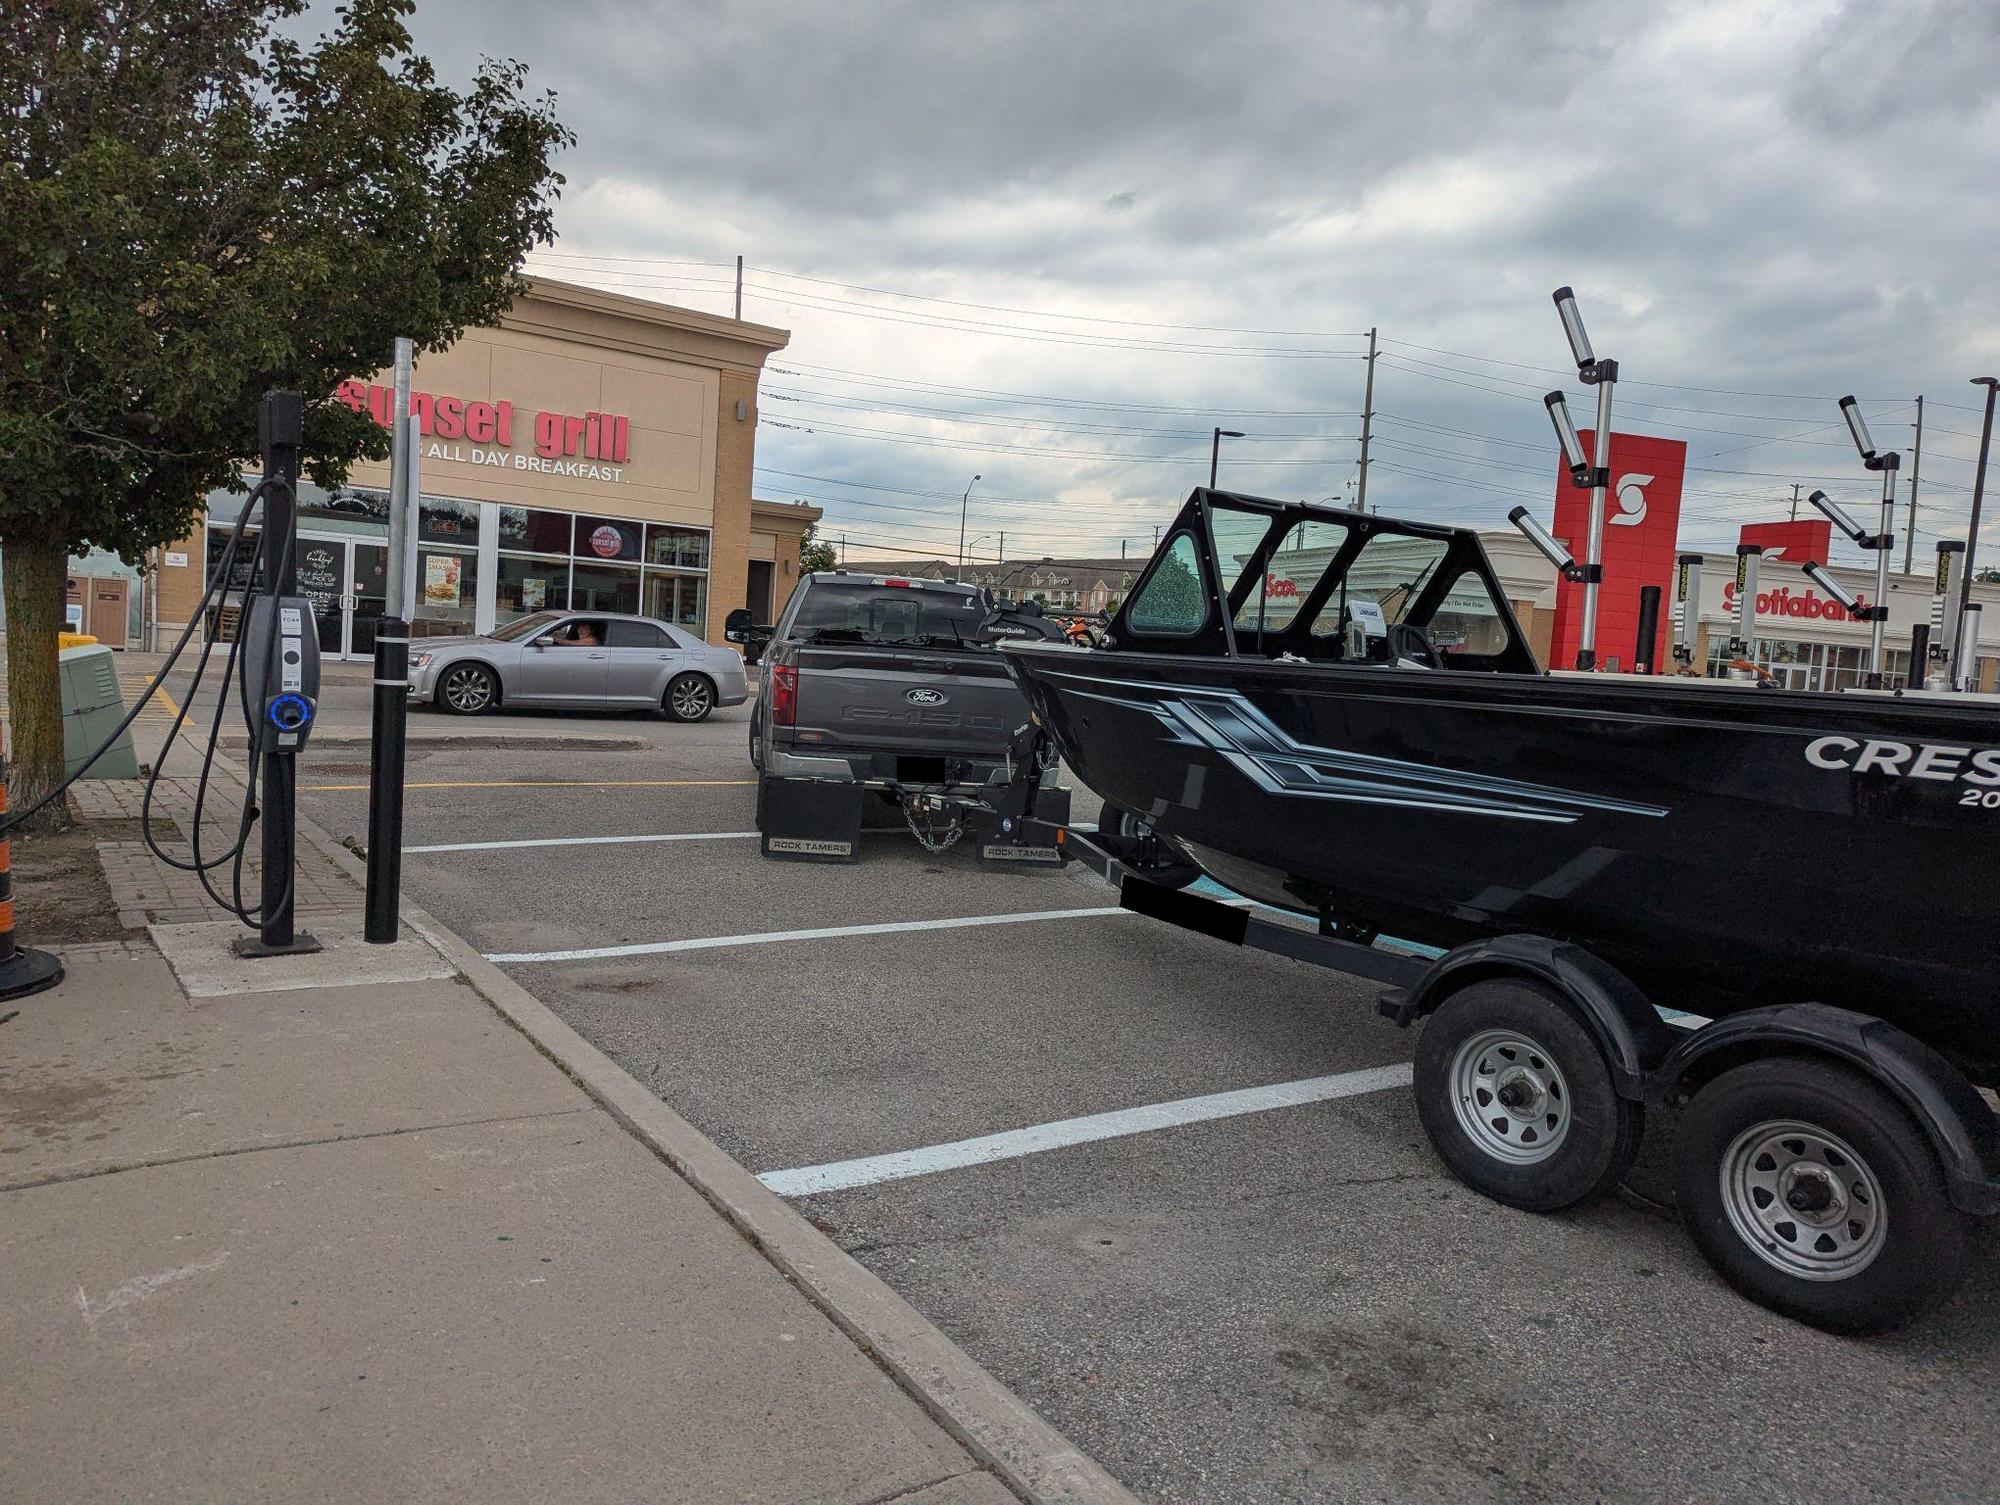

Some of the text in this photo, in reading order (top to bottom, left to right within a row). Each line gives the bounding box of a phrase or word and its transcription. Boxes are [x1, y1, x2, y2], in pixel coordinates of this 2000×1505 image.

[535, 411, 628, 464] grill
[428, 443, 466, 462] ALL
[472, 449, 510, 468] DAY
[514, 455, 623, 483] BREAKFAST
[306, 590, 331, 599] OPEN
[987, 626, 1026, 635] MotorGuide
[913, 690, 938, 702] Ford
[774, 841, 847, 852] ROCK TAMERS
[988, 848, 1057, 859] ROCK TAMERS
